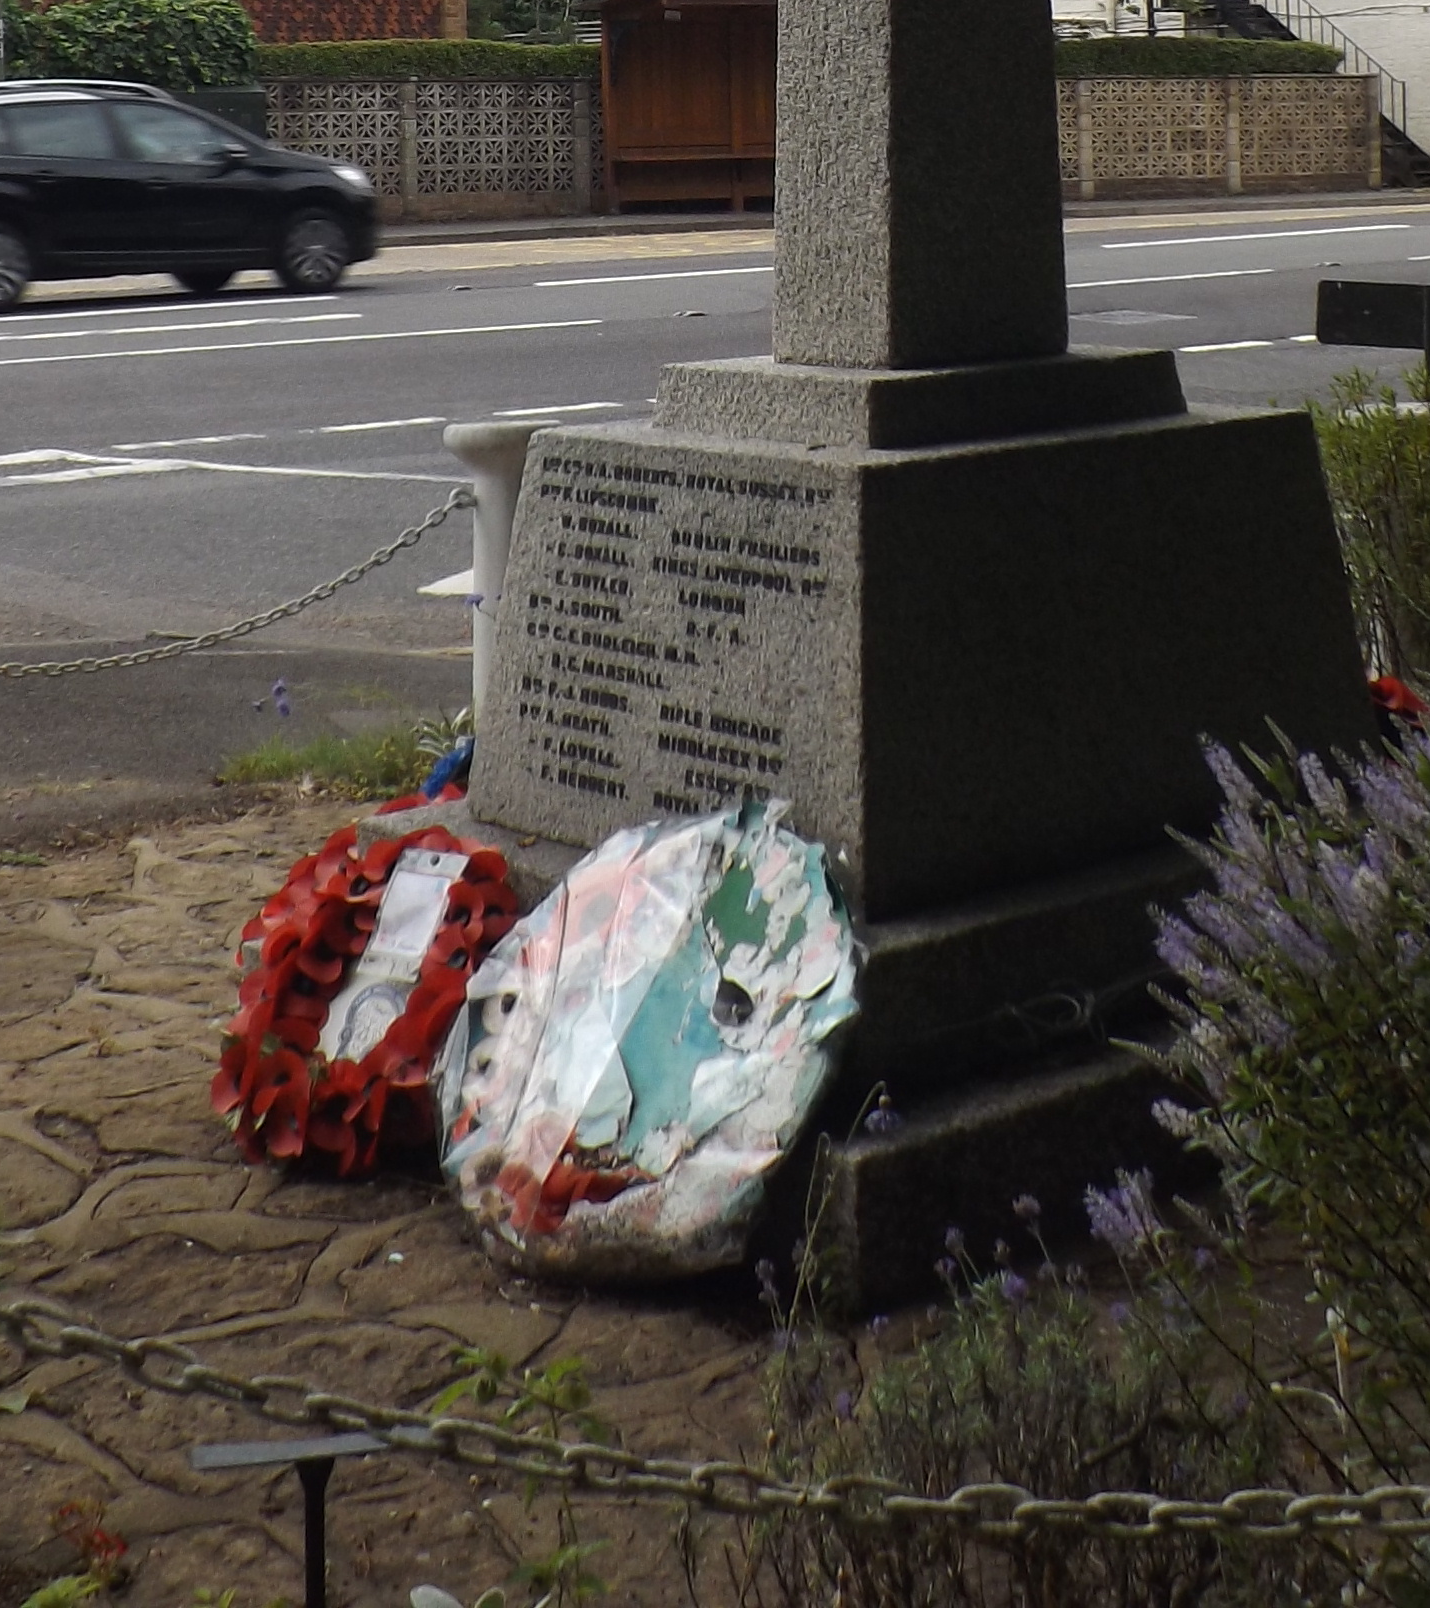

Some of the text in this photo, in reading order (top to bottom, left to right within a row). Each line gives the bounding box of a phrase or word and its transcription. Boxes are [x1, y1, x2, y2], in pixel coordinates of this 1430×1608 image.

[671, 529, 731, 553] DUBLIN
[738, 540, 820, 566] FUSILIERS
[702, 563, 794, 594] LIVERPOOL
[678, 589, 745, 615] LONDON
[659, 704, 703, 729] RIFLE
[710, 714, 782, 745] BRIGADE
[658, 732, 751, 772] MIDDLESEX
[684, 769, 737, 796] ESSEX
